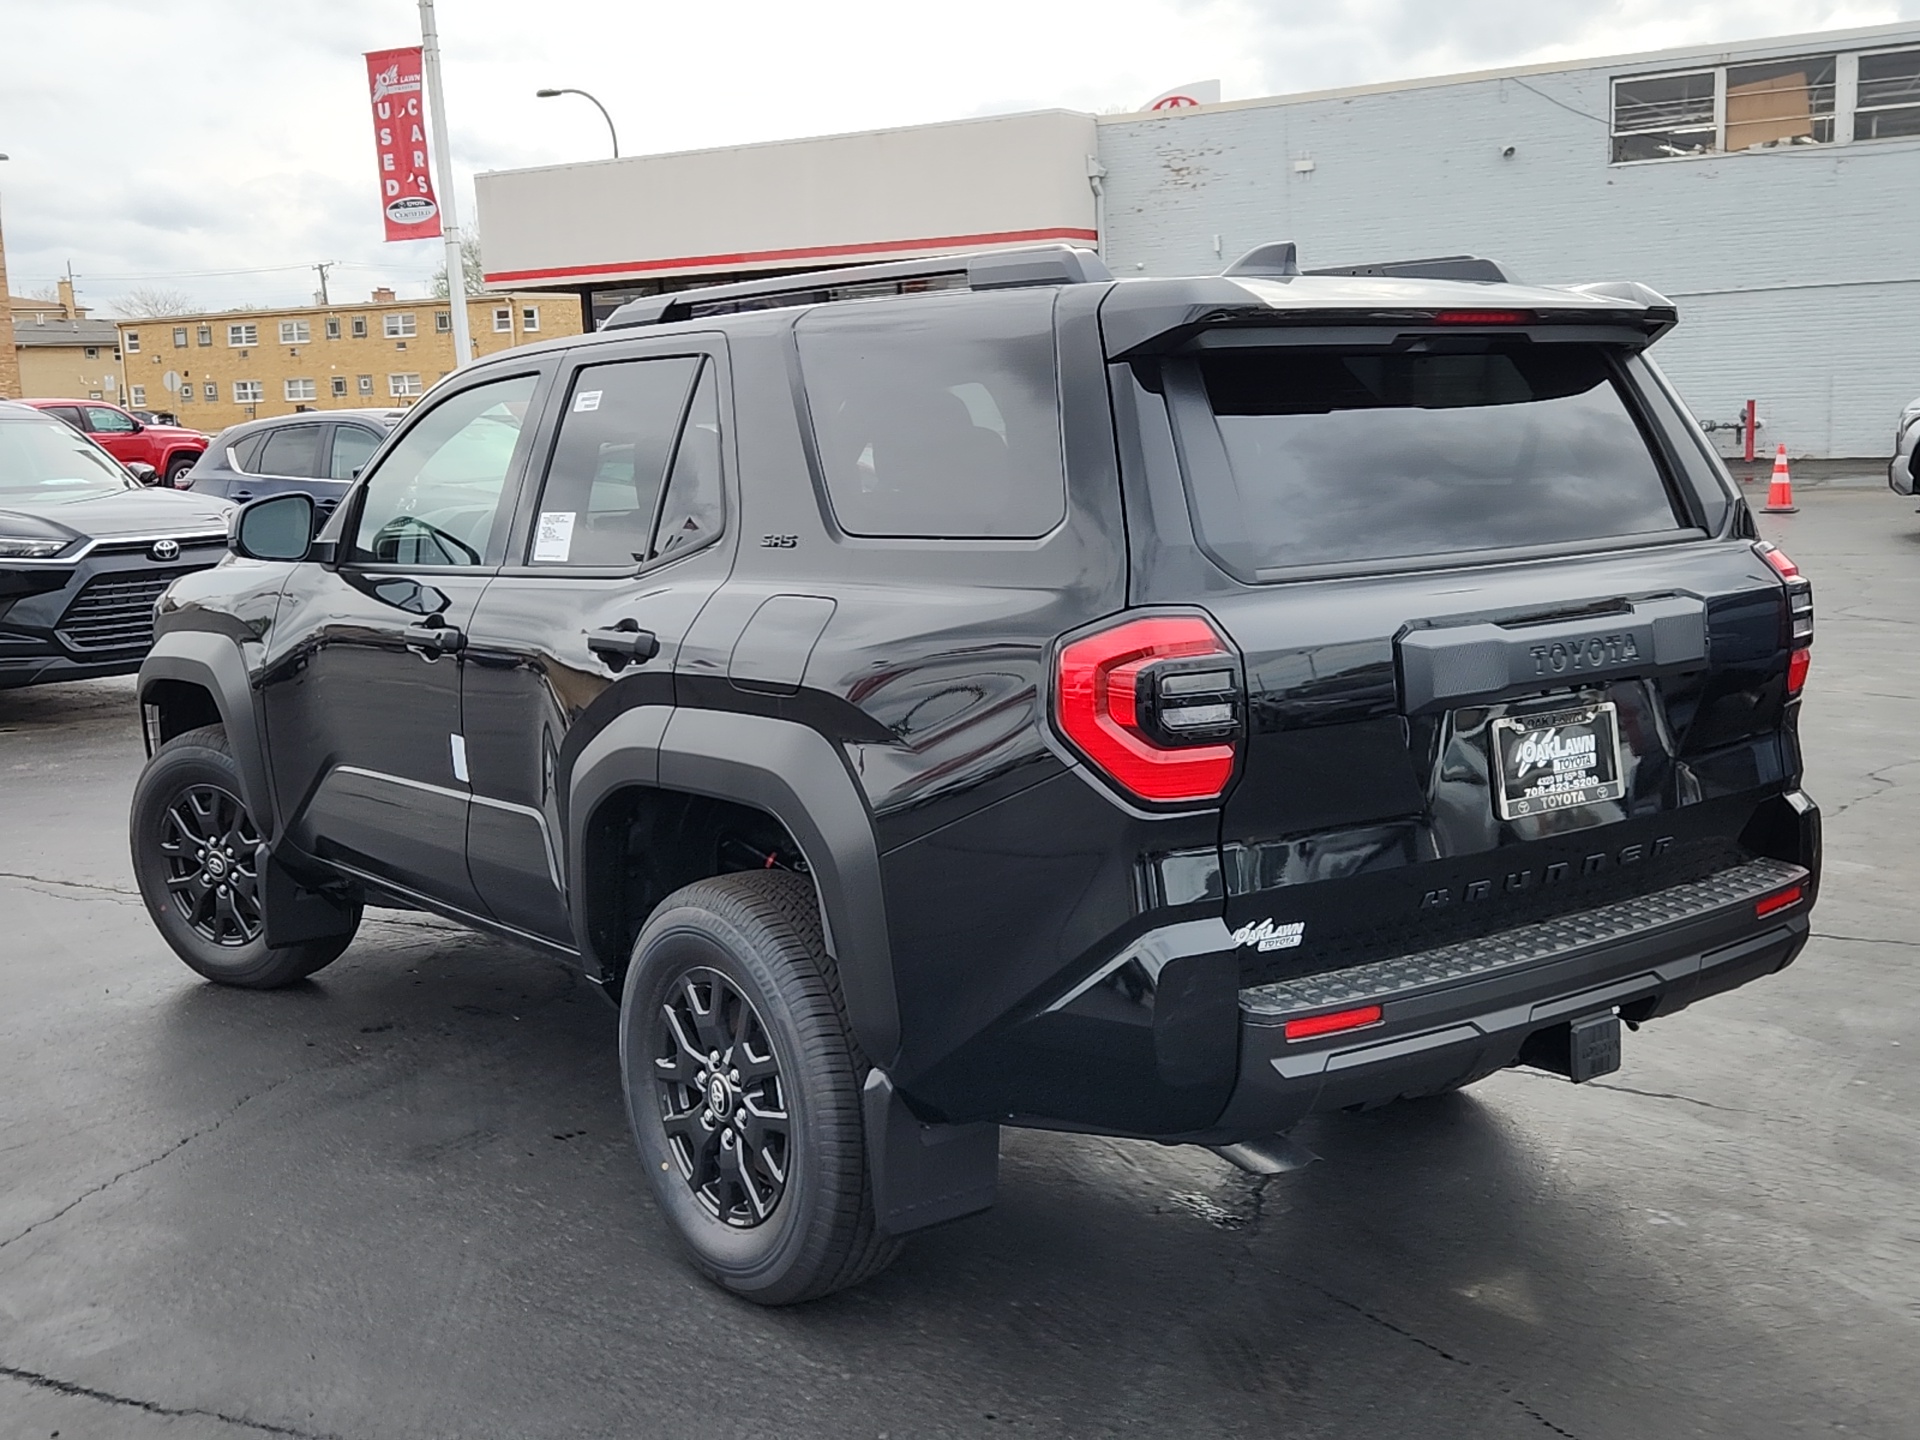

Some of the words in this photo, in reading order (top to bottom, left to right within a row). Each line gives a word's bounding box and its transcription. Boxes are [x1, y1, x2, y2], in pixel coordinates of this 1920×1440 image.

[1529, 633, 1640, 676] TOYOTA
[1559, 754, 1592, 769] TOYOTA
[1523, 775, 1599, 798] 708-423-5200
[1540, 790, 1587, 809] TOYOTA
[1418, 836, 1675, 909] 4RUNNER
[1264, 936, 1295, 948] TOYOTA
